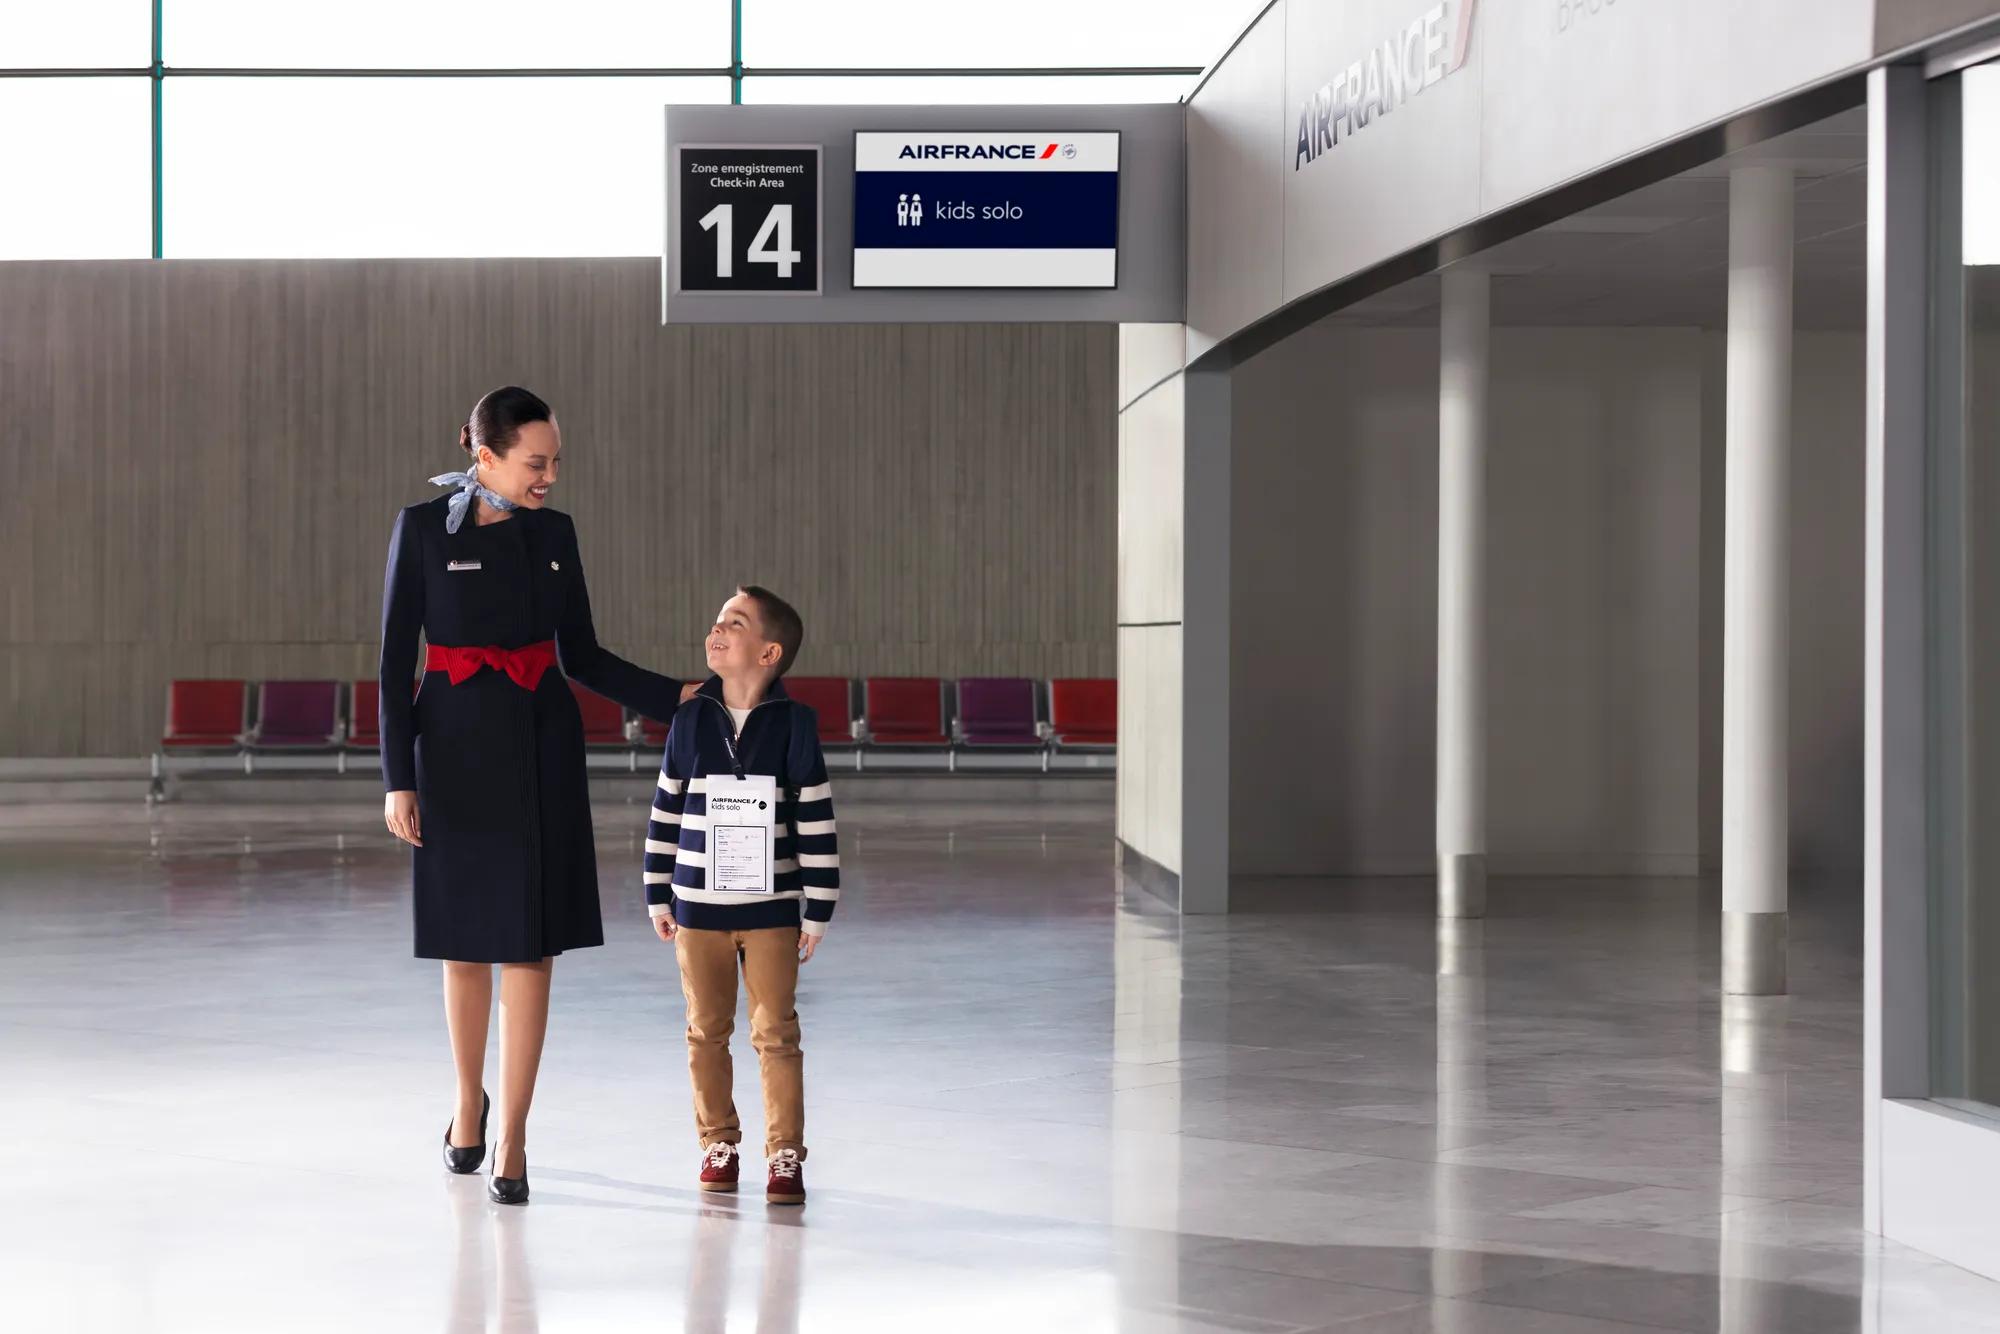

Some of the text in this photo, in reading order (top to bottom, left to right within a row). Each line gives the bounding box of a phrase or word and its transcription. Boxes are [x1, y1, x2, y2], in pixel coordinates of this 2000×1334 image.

[1296, 1, 1447, 172] AIRFRANCE
[899, 144, 1036, 159] AIRFRANCE
[691, 163, 804, 176] Zone enregistrement
[710, 177, 785, 188] Check-in Area
[936, 200, 1023, 220] kids solo
[699, 204, 801, 278] 14
